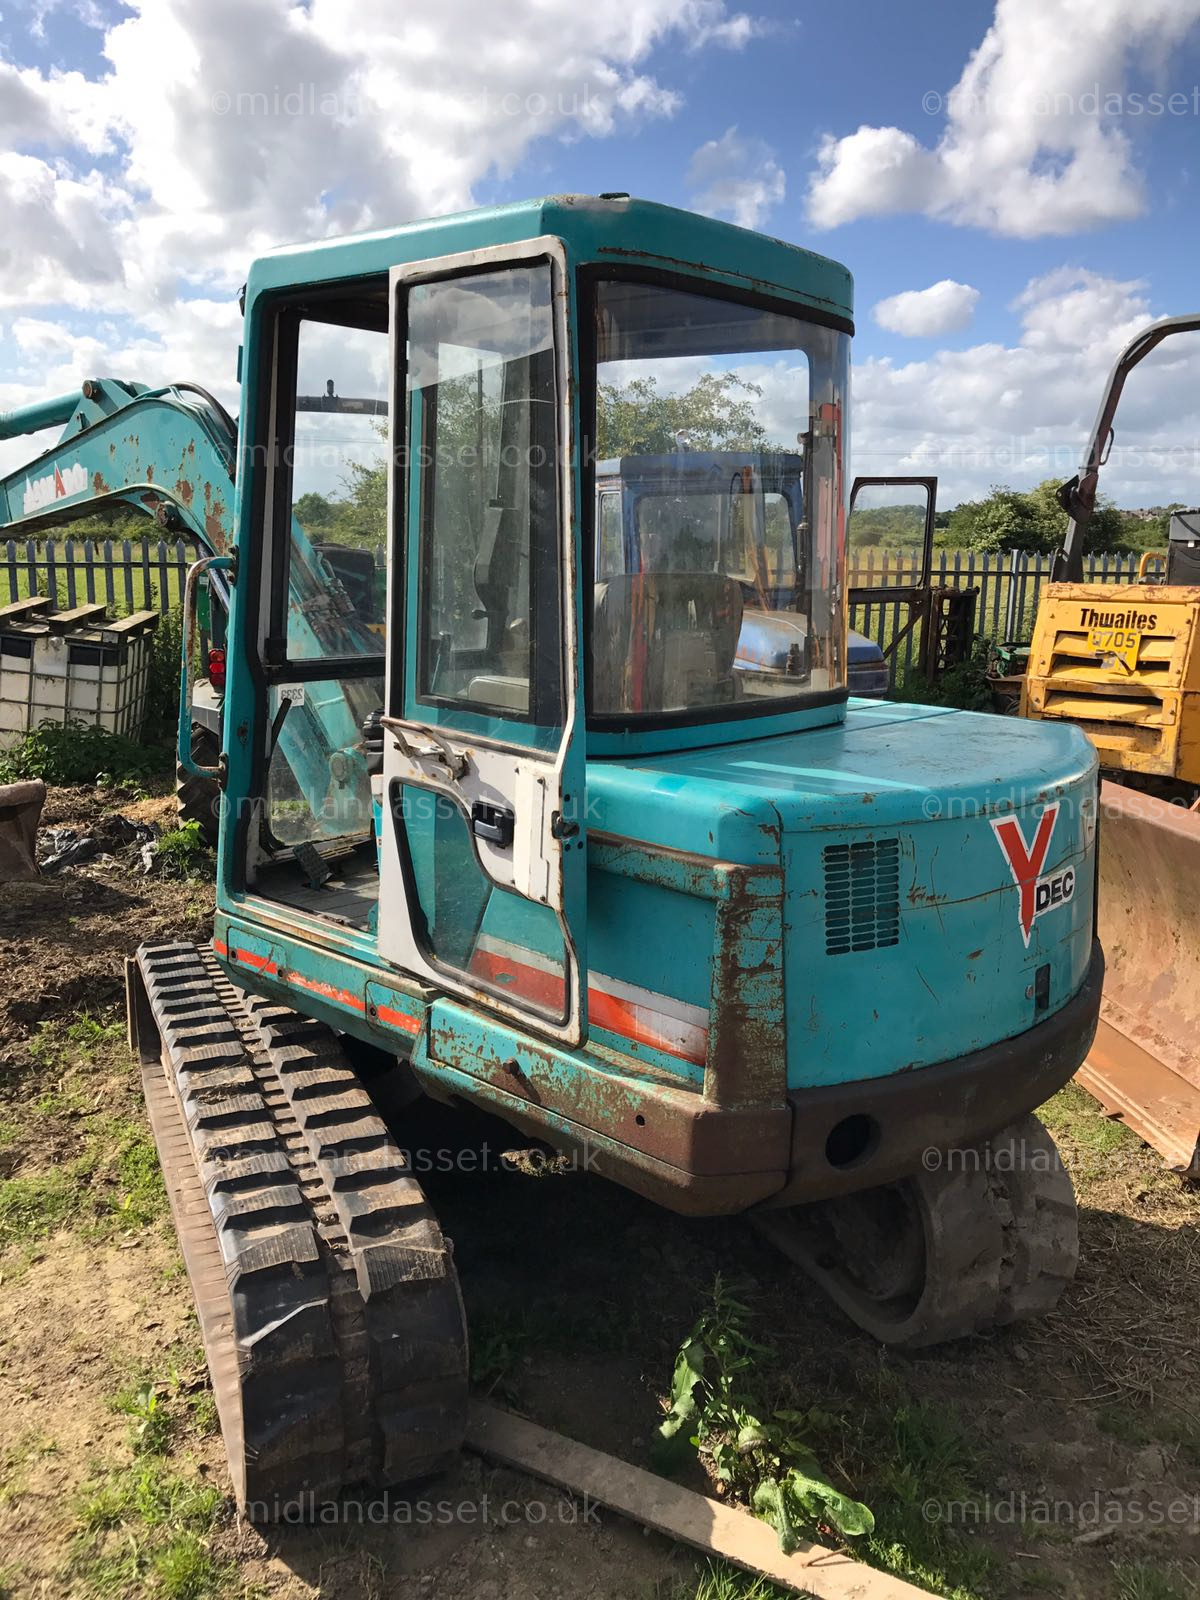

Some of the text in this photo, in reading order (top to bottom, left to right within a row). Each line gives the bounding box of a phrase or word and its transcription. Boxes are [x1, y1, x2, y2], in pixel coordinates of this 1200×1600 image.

[1080, 608, 1158, 630] Thwaites
[992, 804, 1059, 944] Y
[1035, 871, 1074, 913] DEC
